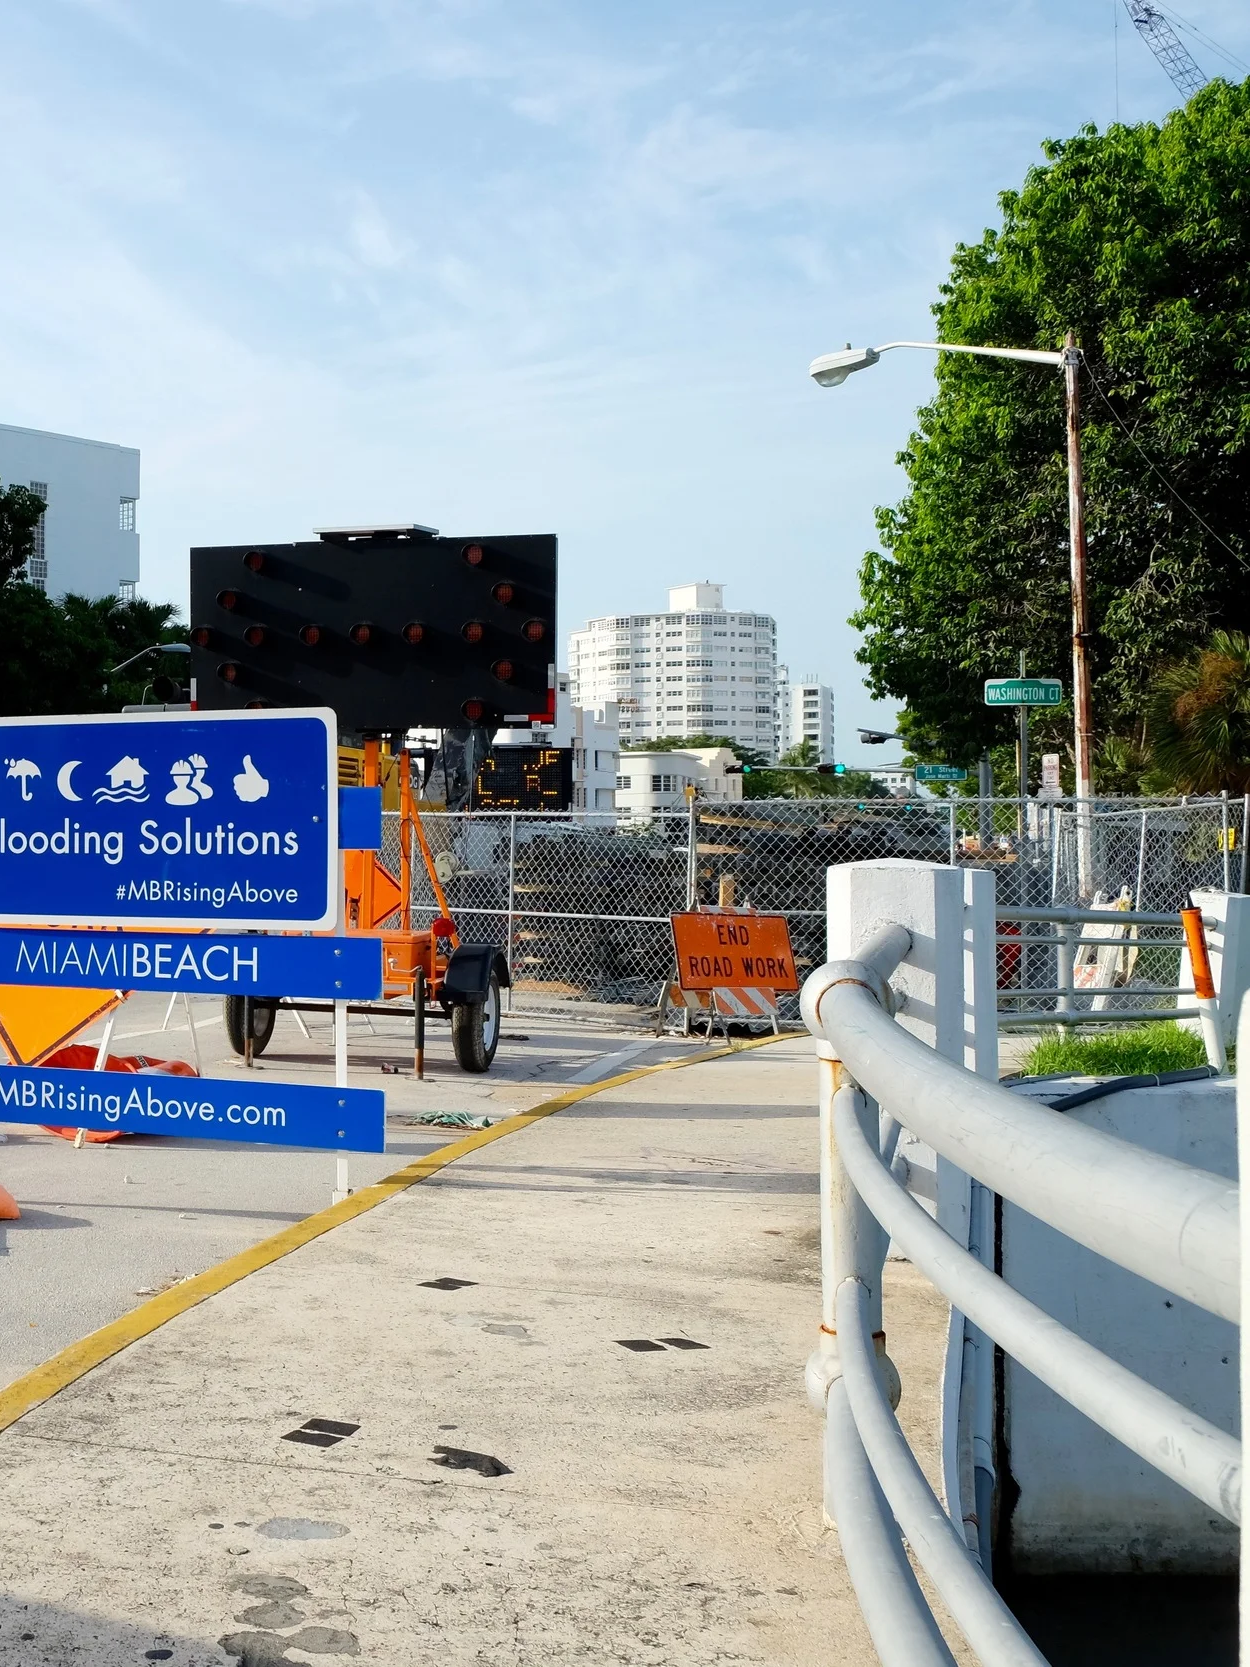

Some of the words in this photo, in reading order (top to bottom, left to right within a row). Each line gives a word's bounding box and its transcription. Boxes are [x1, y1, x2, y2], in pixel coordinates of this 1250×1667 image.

[987, 687, 1045, 701] WASHINGTON
[1049, 687, 1059, 701] CT
[923, 766, 933, 774] 21
[138, 817, 299, 856] Solutions
[115, 879, 299, 909] #MBRisingAbove
[716, 924, 750, 946] END
[688, 956, 733, 978] ROAD
[741, 957, 790, 979] WORK
